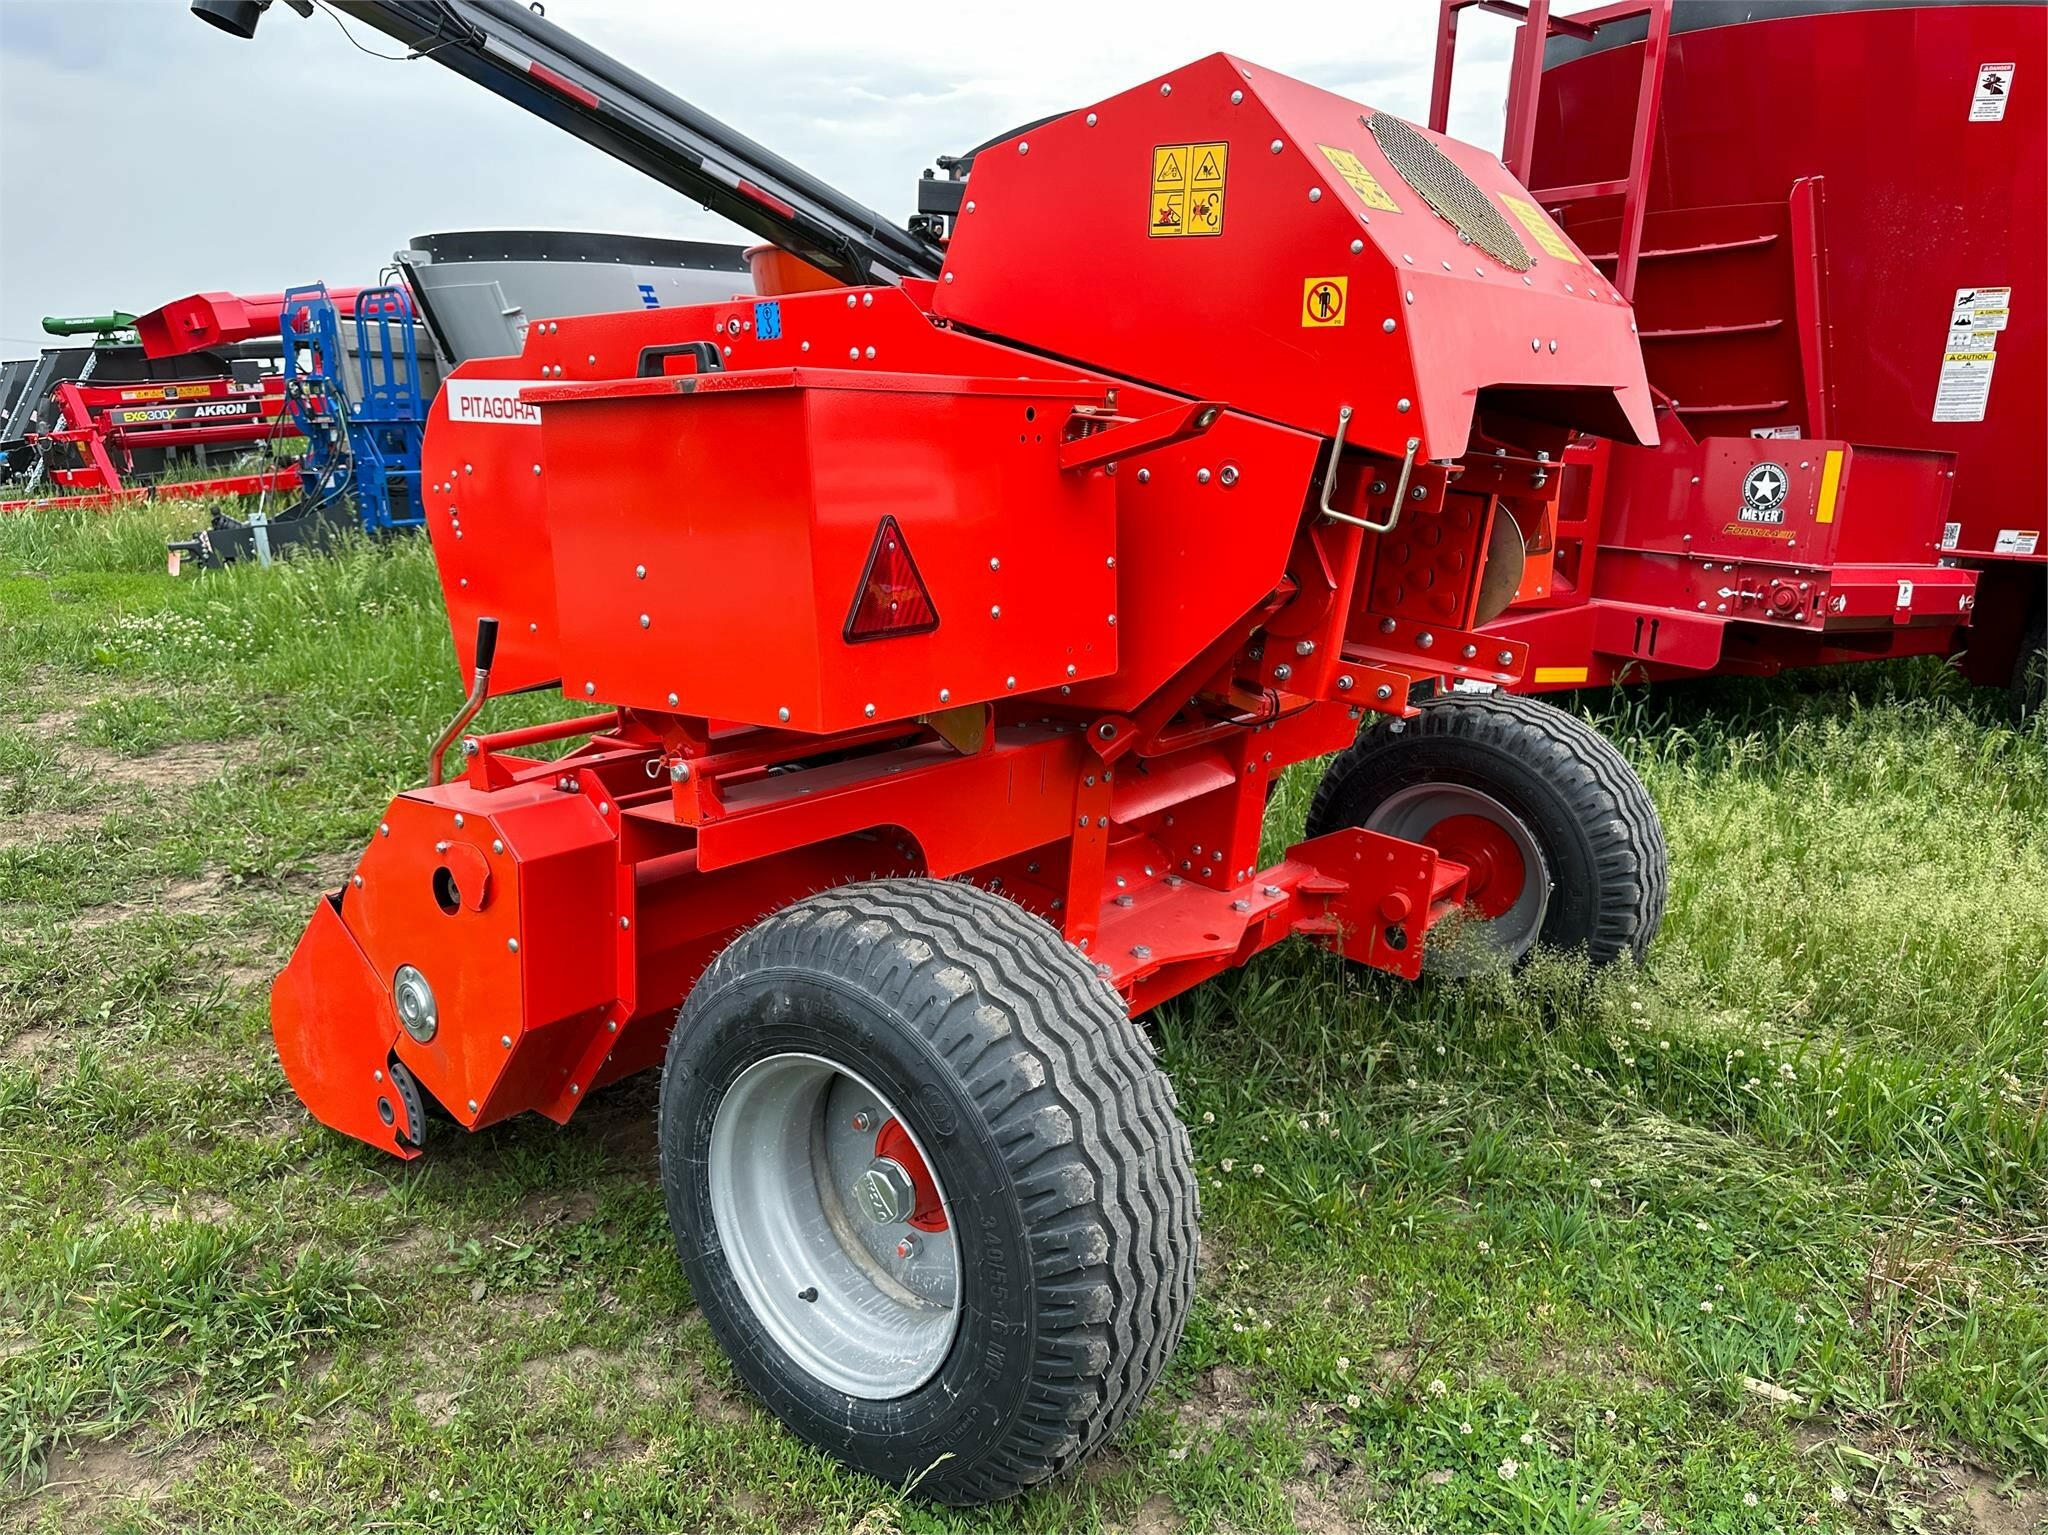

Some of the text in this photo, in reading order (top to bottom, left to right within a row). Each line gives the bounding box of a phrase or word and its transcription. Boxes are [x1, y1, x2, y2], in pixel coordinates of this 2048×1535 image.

[1956, 352, 1988, 360] CAUTION
[123, 403, 247, 422] EXG300X AKRON
[460, 396, 537, 420] PITAGORA
[1741, 507, 1779, 523] MEYER
